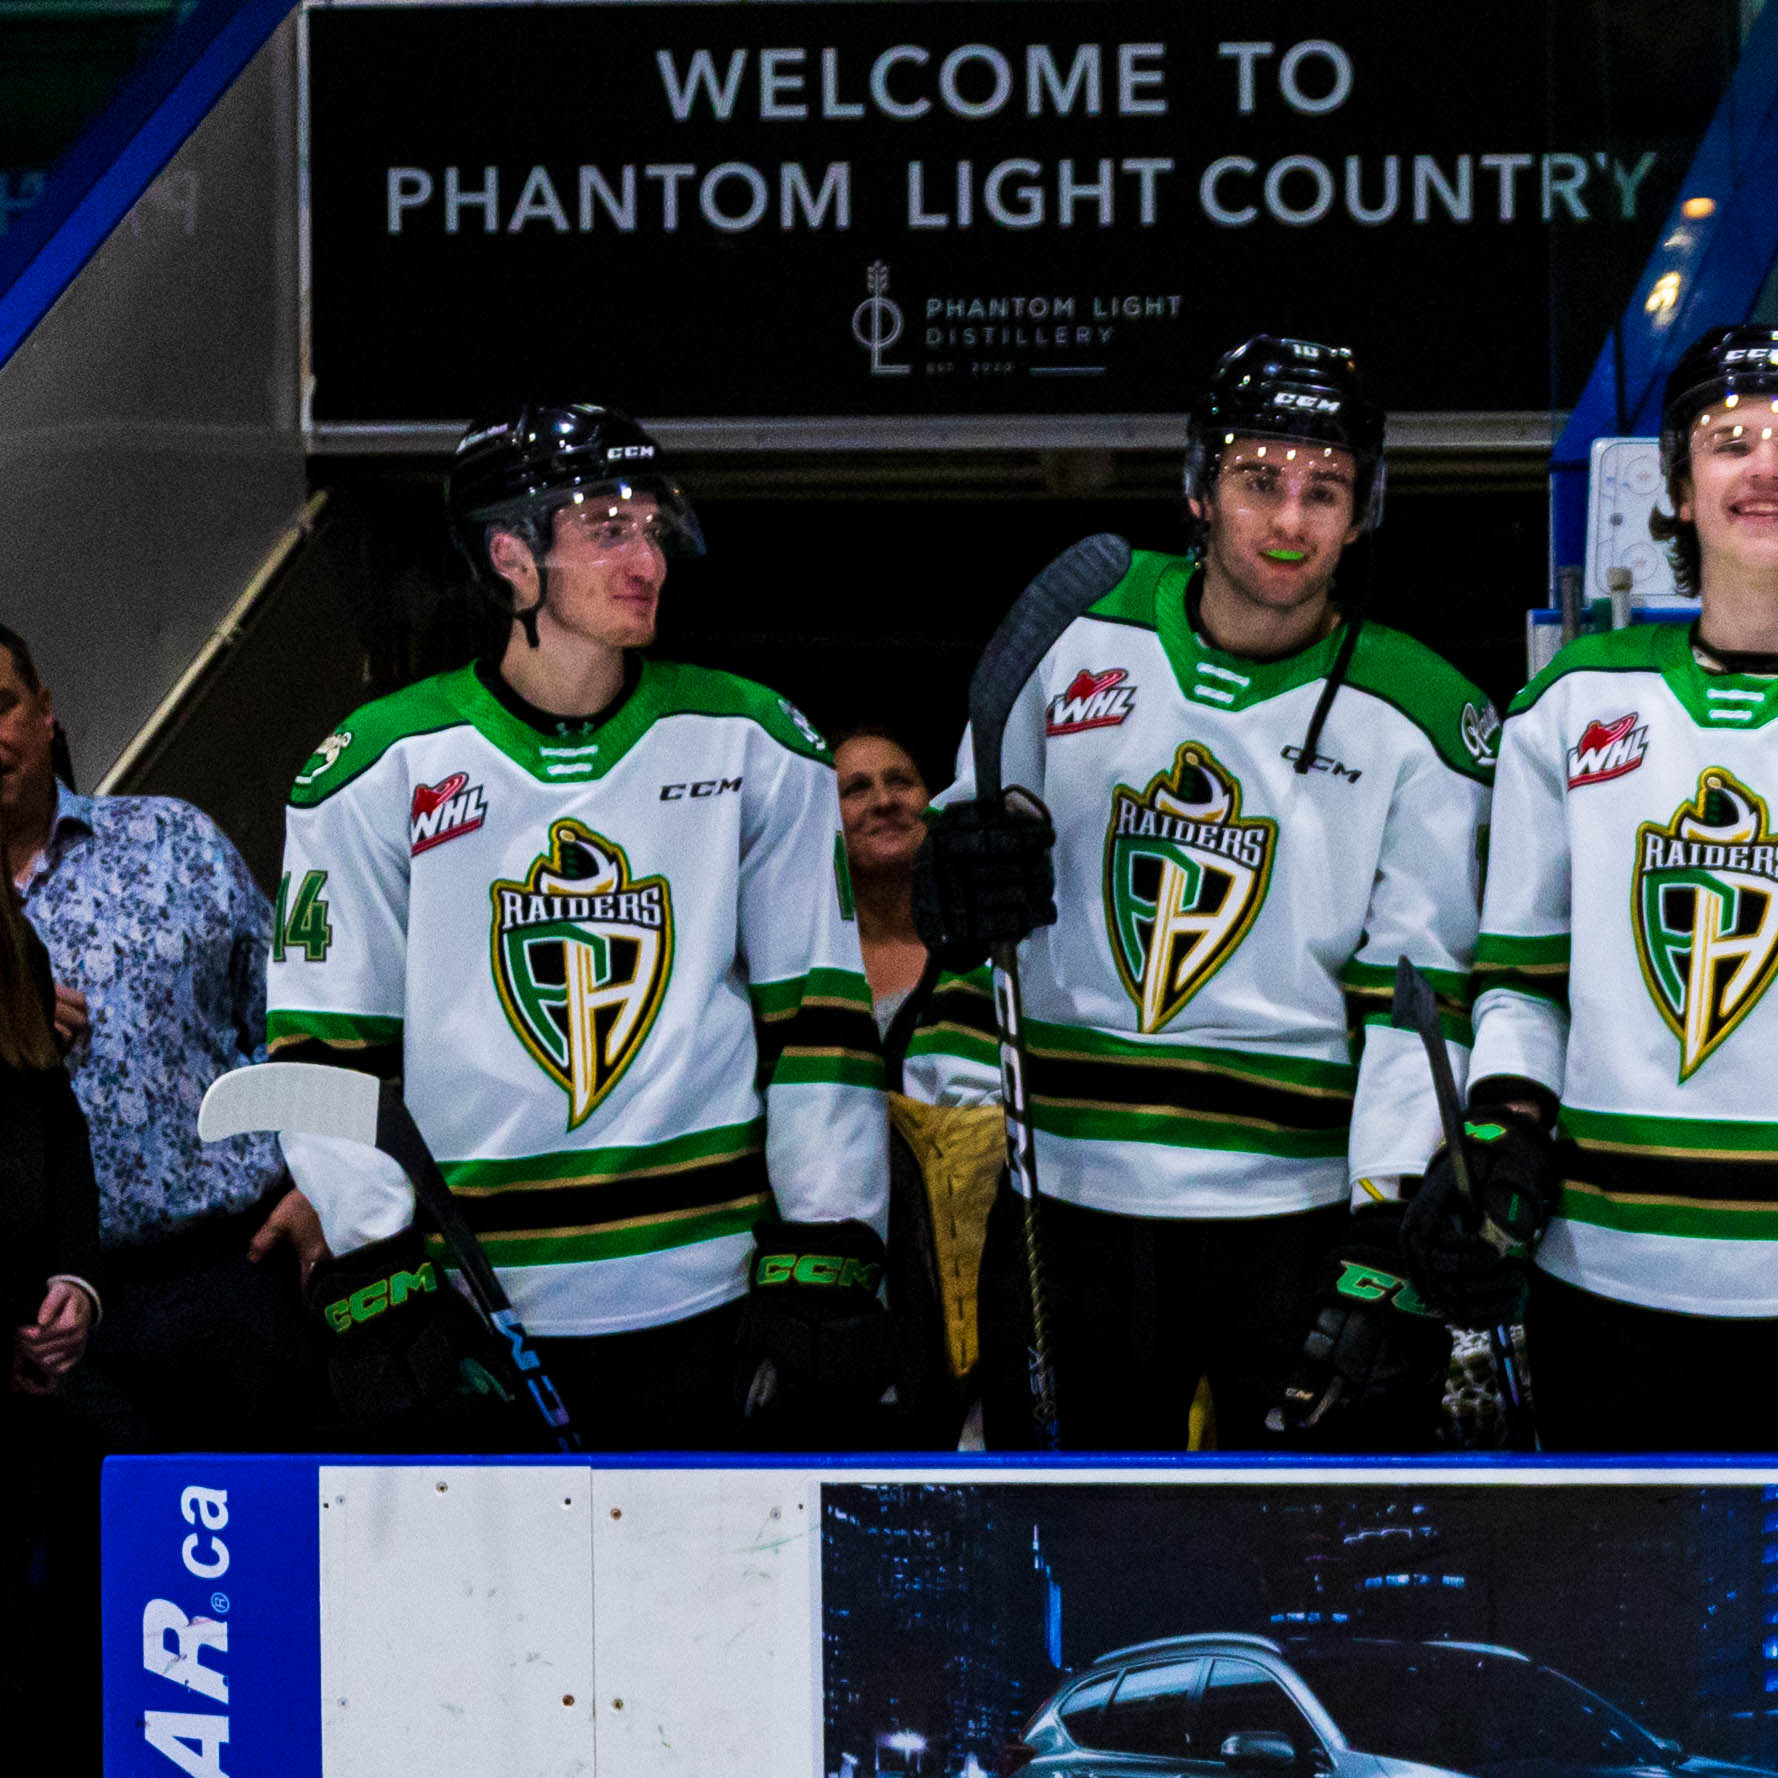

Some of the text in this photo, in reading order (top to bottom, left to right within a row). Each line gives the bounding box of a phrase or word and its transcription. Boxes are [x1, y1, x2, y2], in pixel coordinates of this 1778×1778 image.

[656, 40, 1353, 122] WELCOME TO
[387, 151, 1658, 234] PHANTOM LIGHT COUNTRY
[926, 295, 1183, 320] PHANTOM LIGHT
[926, 326, 1114, 347] DISTILLERY
[1273, 392, 1341, 413] CCM
[606, 446, 655, 460] CCM
[1049, 686, 1137, 725] WHL
[1568, 727, 1648, 778] WHL
[660, 776, 742, 801] CCM
[411, 784, 487, 840] WHL
[1115, 796, 1266, 869] RAIDERS
[501, 885, 663, 931] RAIDERS
[993, 965, 1034, 1200] CCM
[756, 1252, 880, 1289] CCM
[324, 1260, 440, 1336] CCM
